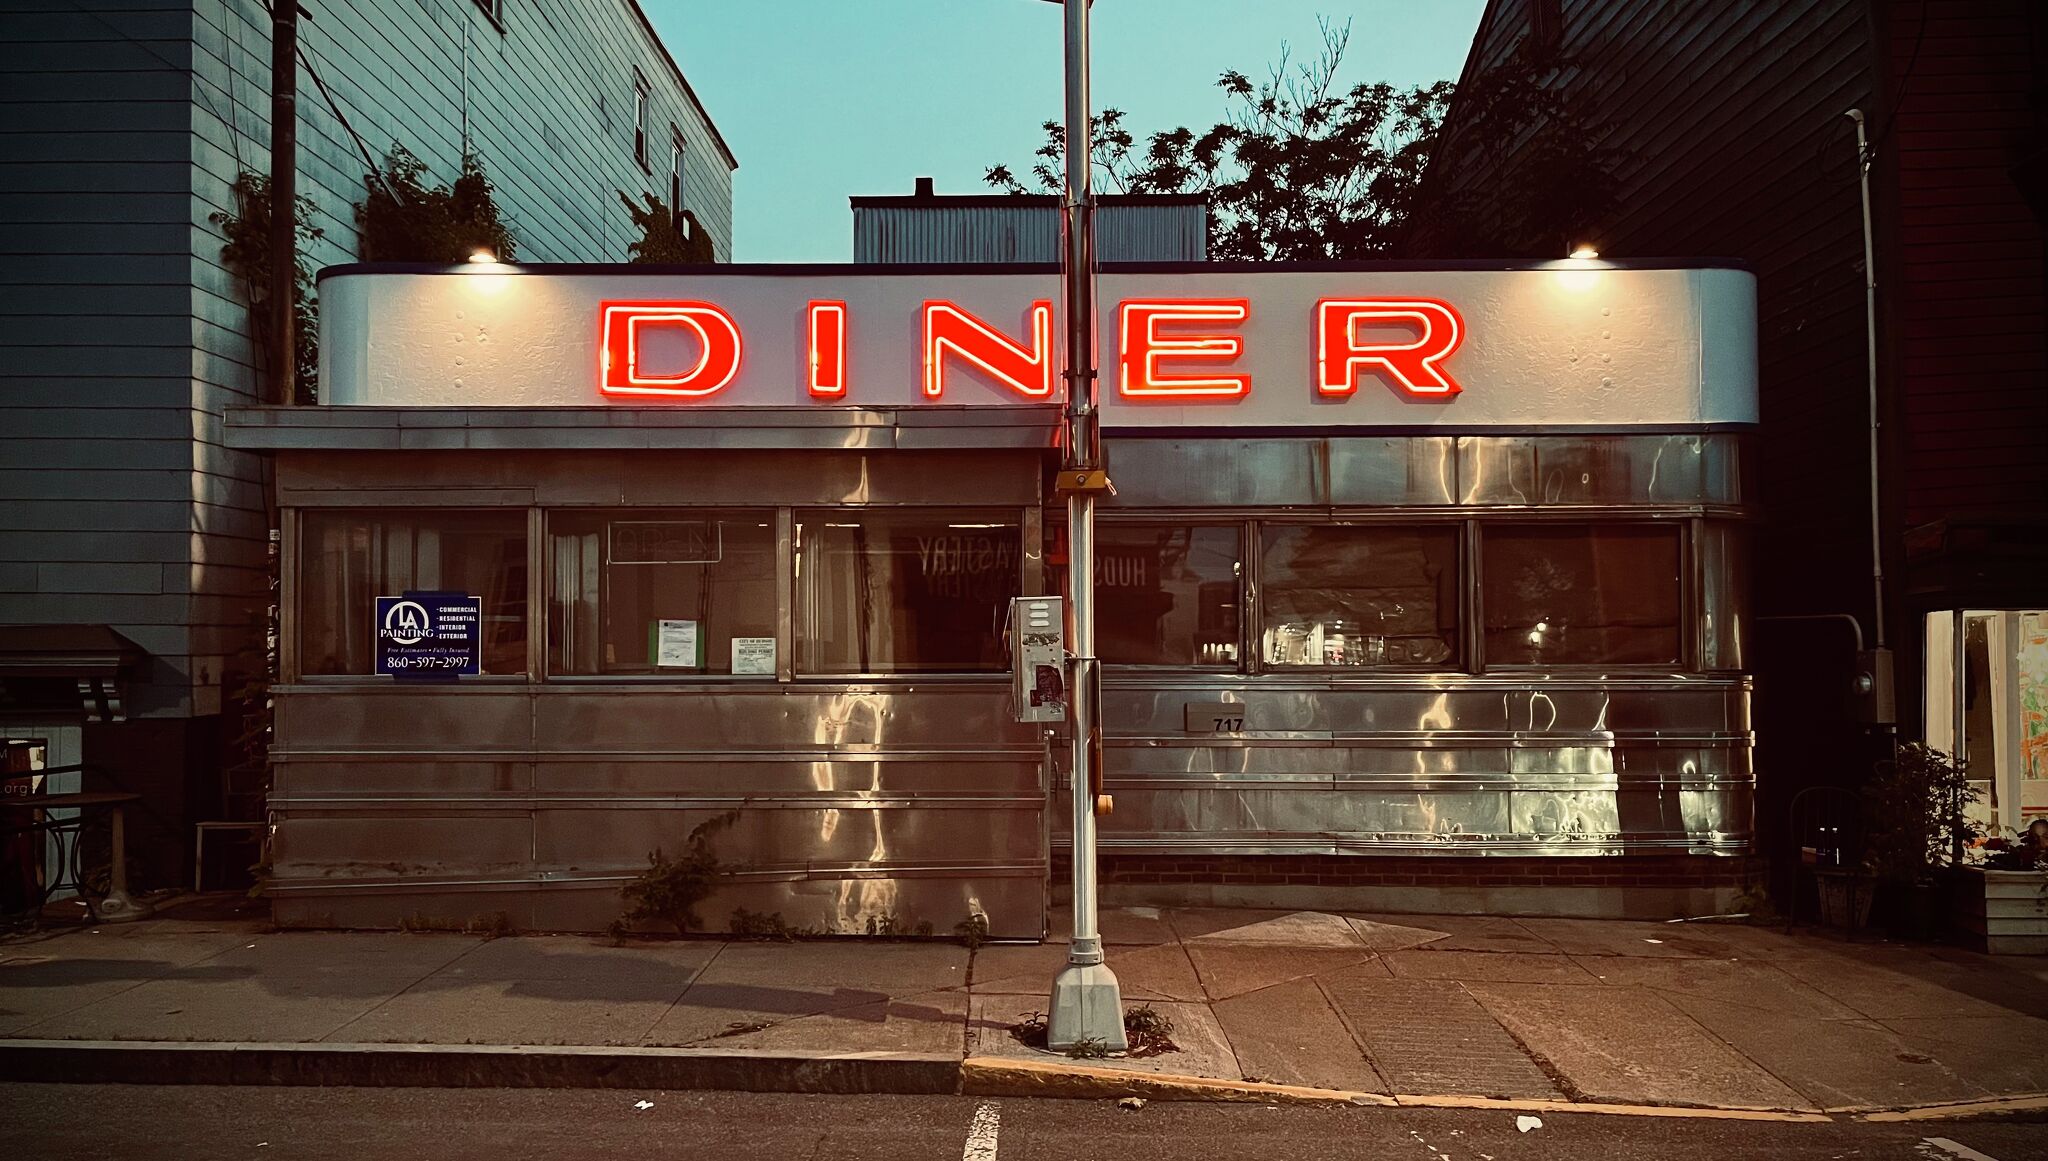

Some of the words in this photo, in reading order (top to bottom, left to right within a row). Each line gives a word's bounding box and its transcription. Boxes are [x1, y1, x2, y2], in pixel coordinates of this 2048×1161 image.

[600, 298, 1465, 397] DINER
[398, 604, 418, 629] LA
[380, 629, 434, 638] PAINTING
[387, 657, 469, 668] 860-597-2997
[1213, 719, 1244, 731] 717
